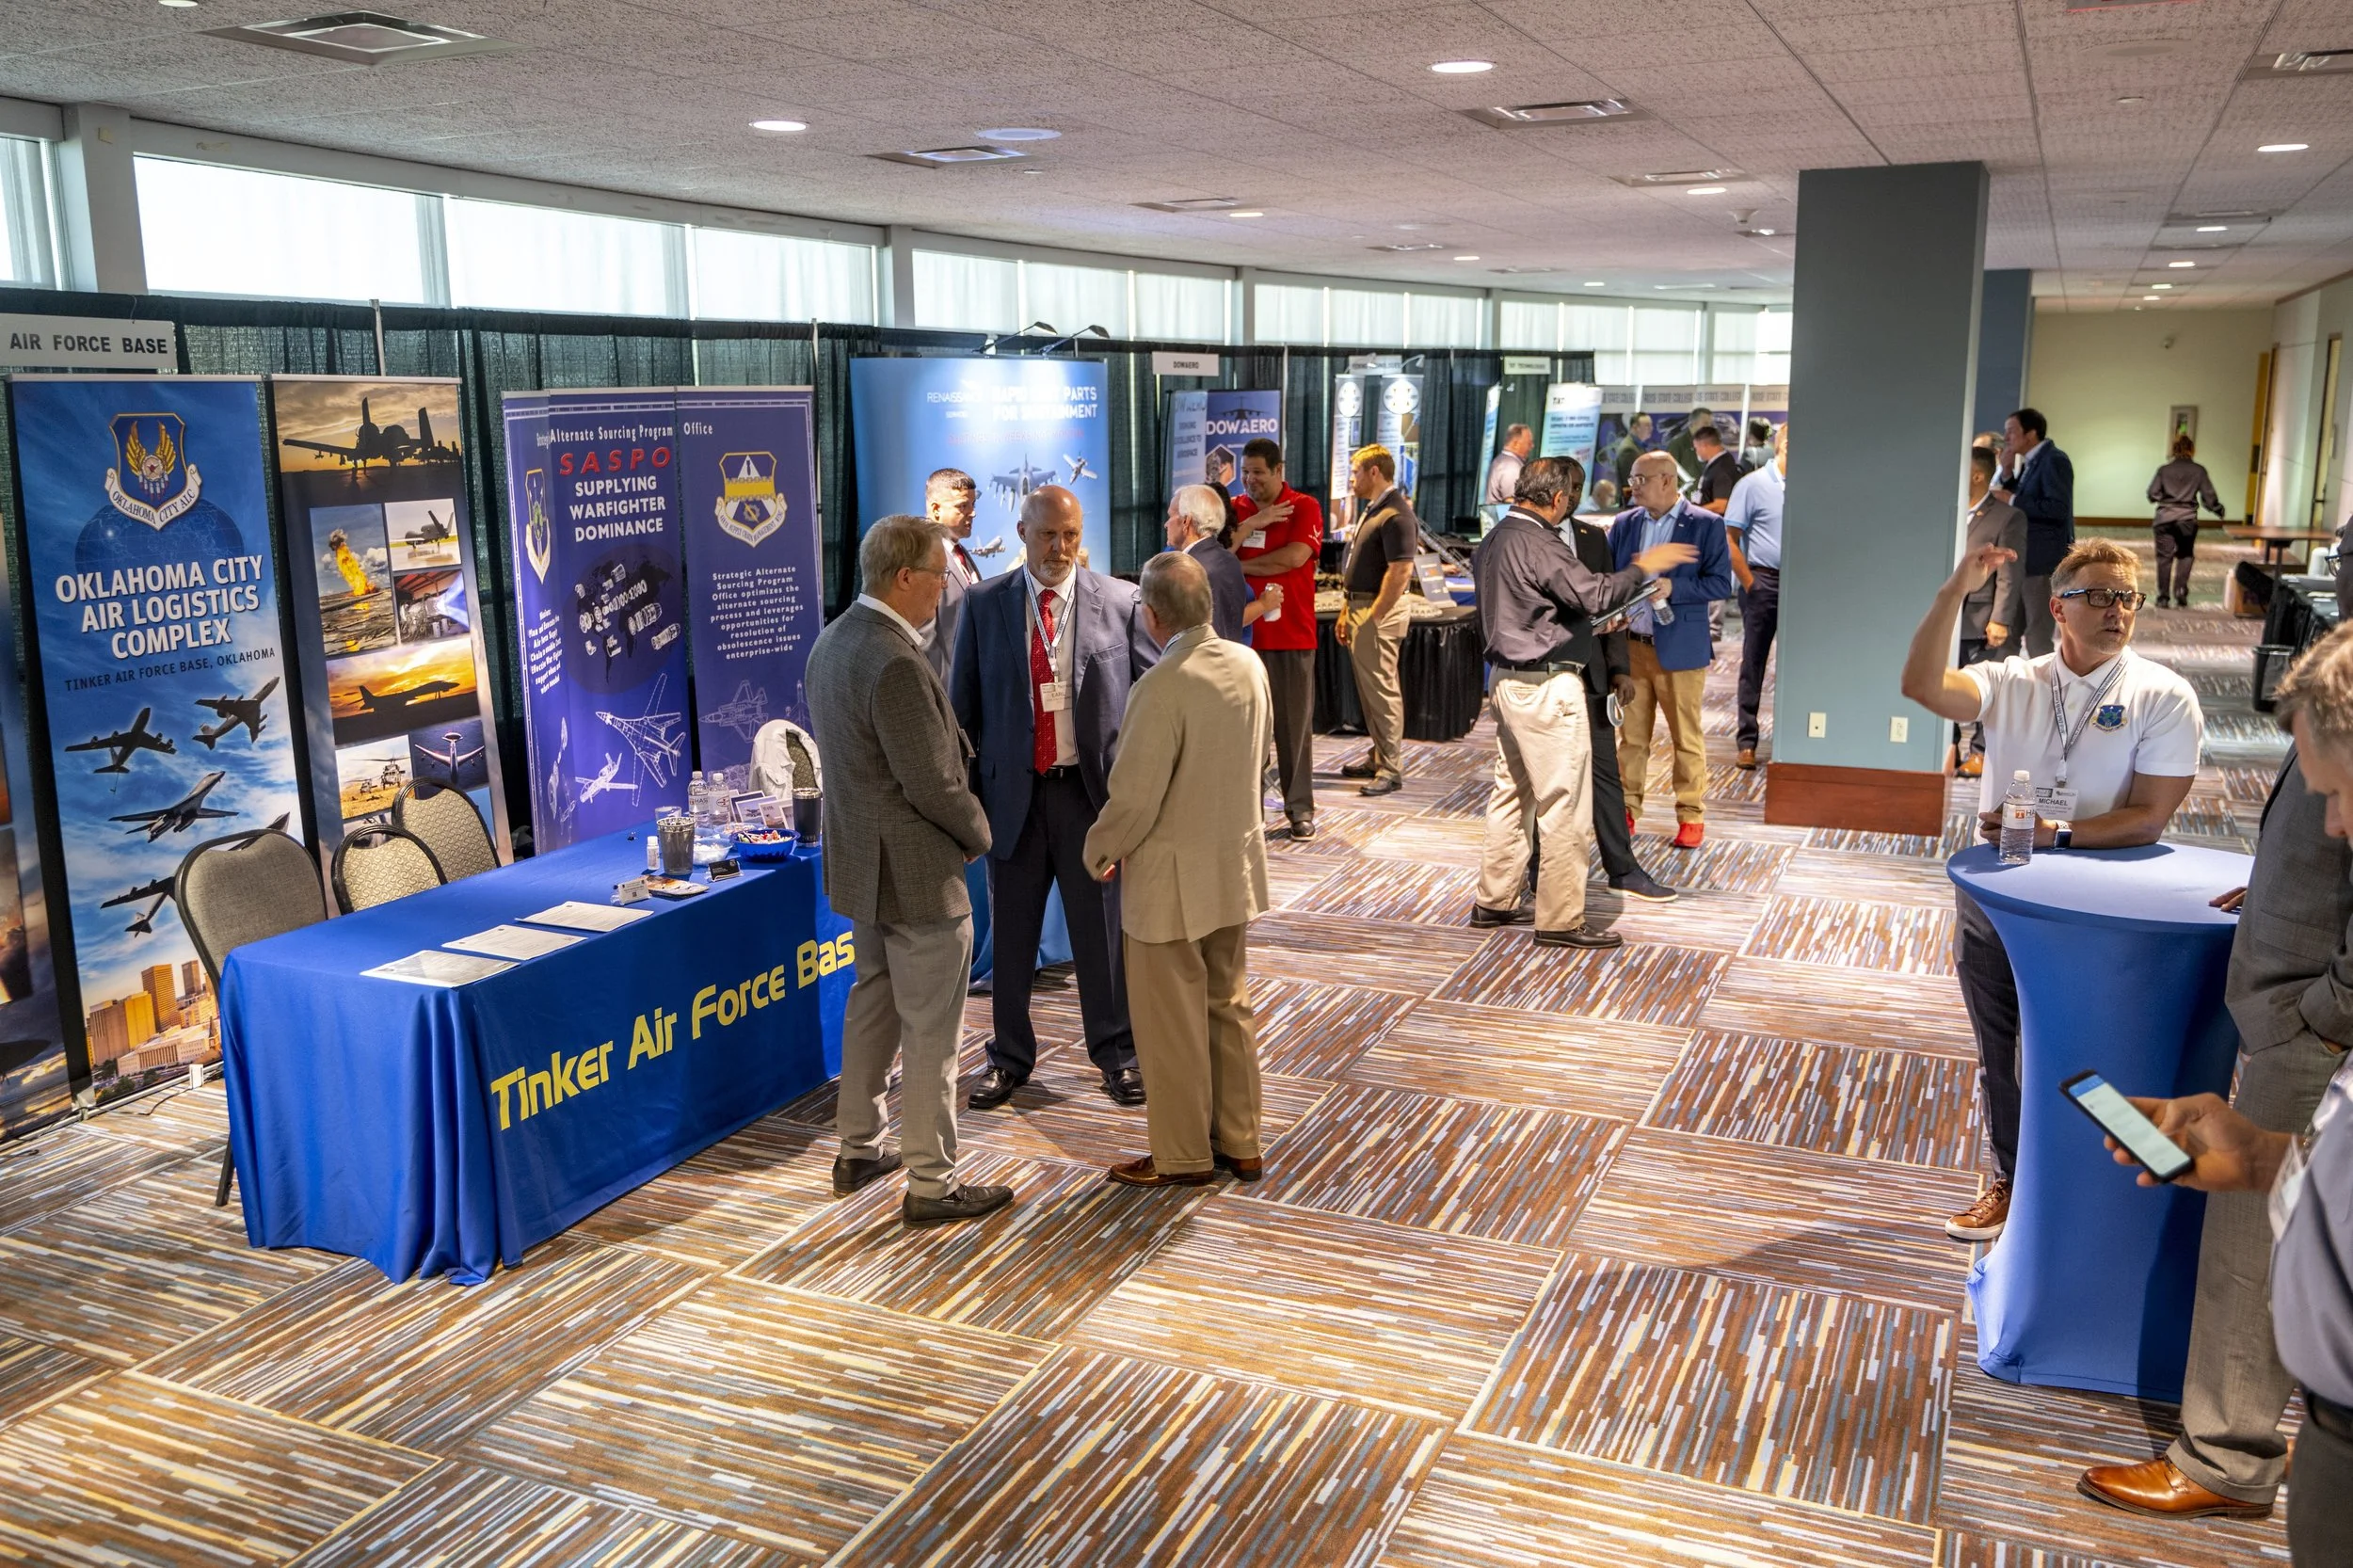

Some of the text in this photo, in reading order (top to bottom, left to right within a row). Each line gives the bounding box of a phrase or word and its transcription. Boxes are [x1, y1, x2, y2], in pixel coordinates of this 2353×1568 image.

[9, 333, 168, 354] AIR FORCE BASE
[1173, 360, 1199, 369] DOWAERO
[1064, 386, 1097, 401] PARTS
[551, 428, 594, 443] Alternate
[599, 425, 636, 442] Sourcing
[639, 424, 673, 440] Program
[683, 422, 712, 435] Office
[1206, 418, 1278, 435] DOWAERO
[559, 446, 671, 475] SASPO
[575, 475, 657, 497] SUPPLYING
[113, 488, 195, 524] OKLAHOMA CITY ALC
[569, 496, 665, 520] WARFIGHTER
[575, 518, 664, 542] DOMINANCE
[55, 554, 263, 603] OKLAHOMA CITY
[712, 566, 796, 581] Strategic Alternate
[716, 576, 793, 590] Sourcing Program
[712, 591, 738, 600] Office
[741, 587, 782, 599] optimizes
[716, 595, 796, 611] alternate sourcing
[81, 585, 260, 633] AIR LOGISTICS
[710, 604, 804, 623] process and leverages
[721, 617, 779, 631] opportunities
[730, 627, 775, 639] resolution
[111, 617, 232, 659] COMPLEX
[717, 633, 801, 651] obsolescence issues
[726, 644, 793, 660] enterprise-wide
[64, 648, 276, 691] TINKER AIR FORCE BASE, OKLAHOMA
[490, 931, 856, 1130] Tinker Air Force Bas
